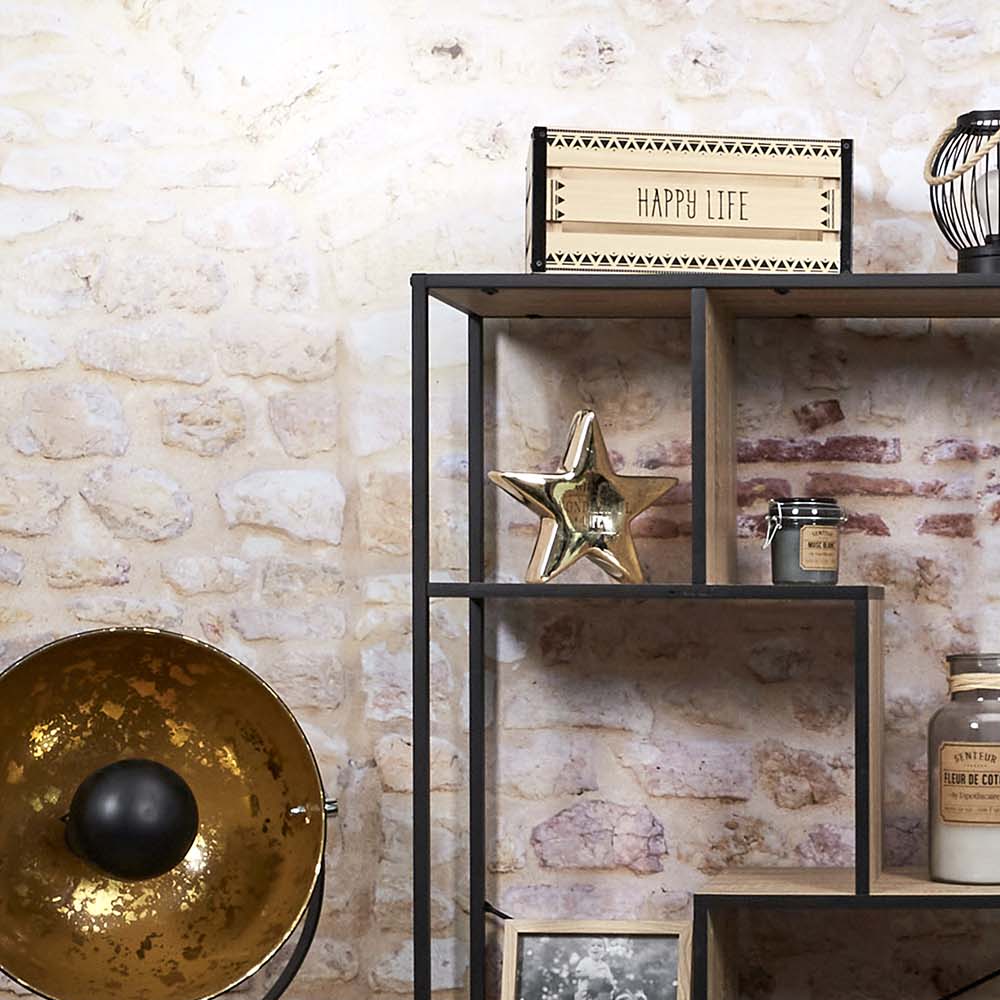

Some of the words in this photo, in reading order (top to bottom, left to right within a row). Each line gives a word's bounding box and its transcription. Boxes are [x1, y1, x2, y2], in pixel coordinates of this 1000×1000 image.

[638, 187, 696, 219] HAPPY
[707, 189, 749, 221] LIFE
[954, 751, 997, 763] SENTEUR
[944, 772, 966, 785] FLEUR
[969, 773, 979, 785] DE
